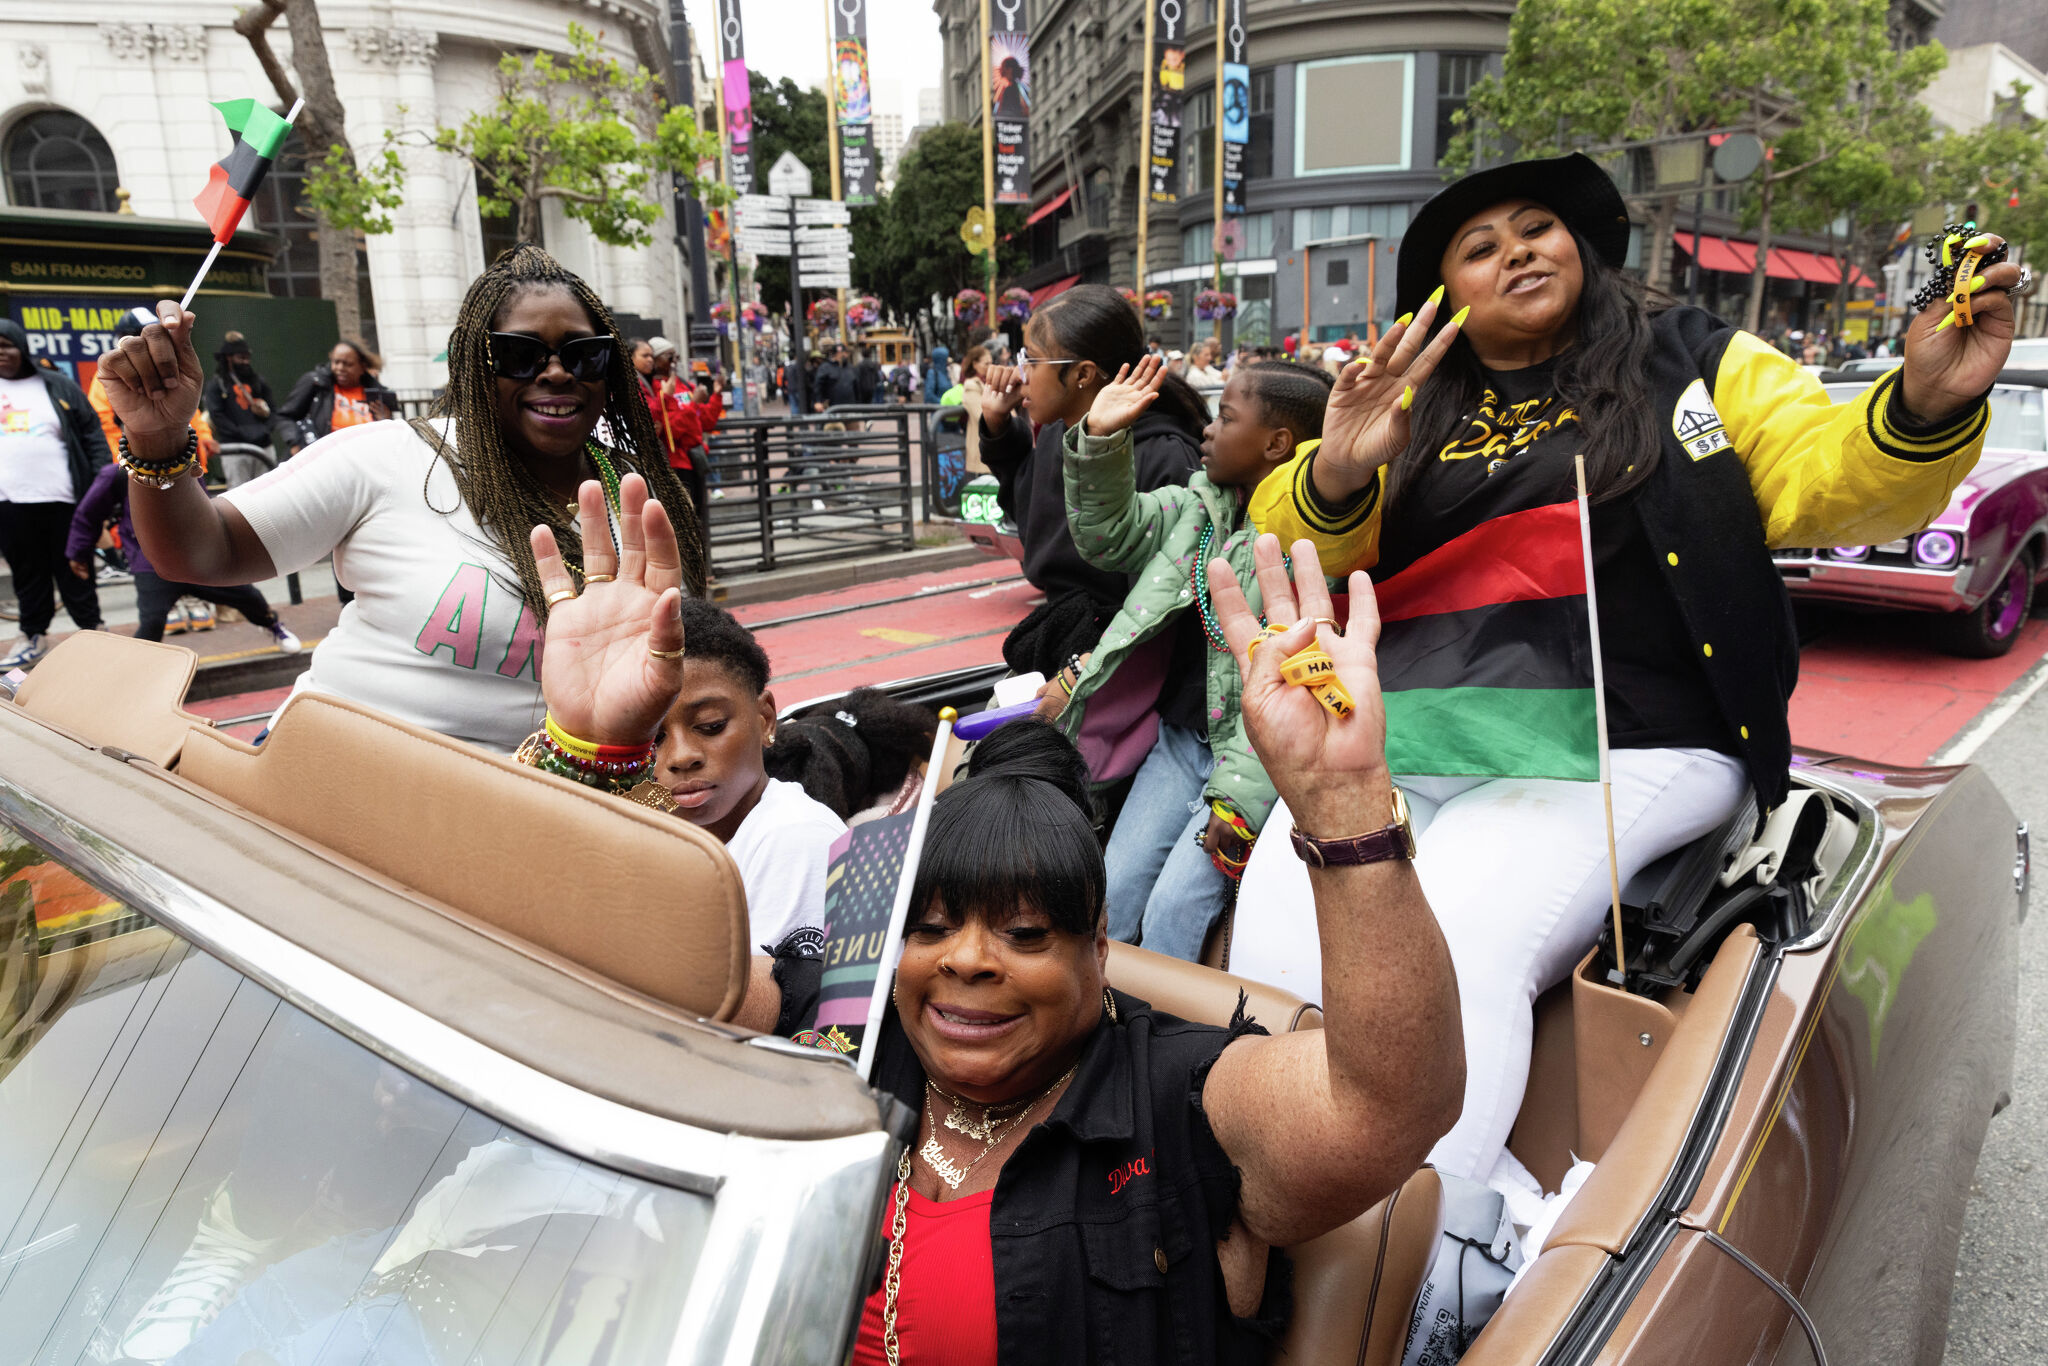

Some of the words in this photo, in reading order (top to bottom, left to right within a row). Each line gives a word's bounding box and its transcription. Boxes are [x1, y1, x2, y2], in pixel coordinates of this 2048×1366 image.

[10, 262, 47, 276] SAN
[50, 263, 146, 279] FRANCISCO
[1959, 254, 1978, 282] HAPPY
[26, 333, 72, 355] PIT
[1108, 1157, 1150, 1194] Diva
